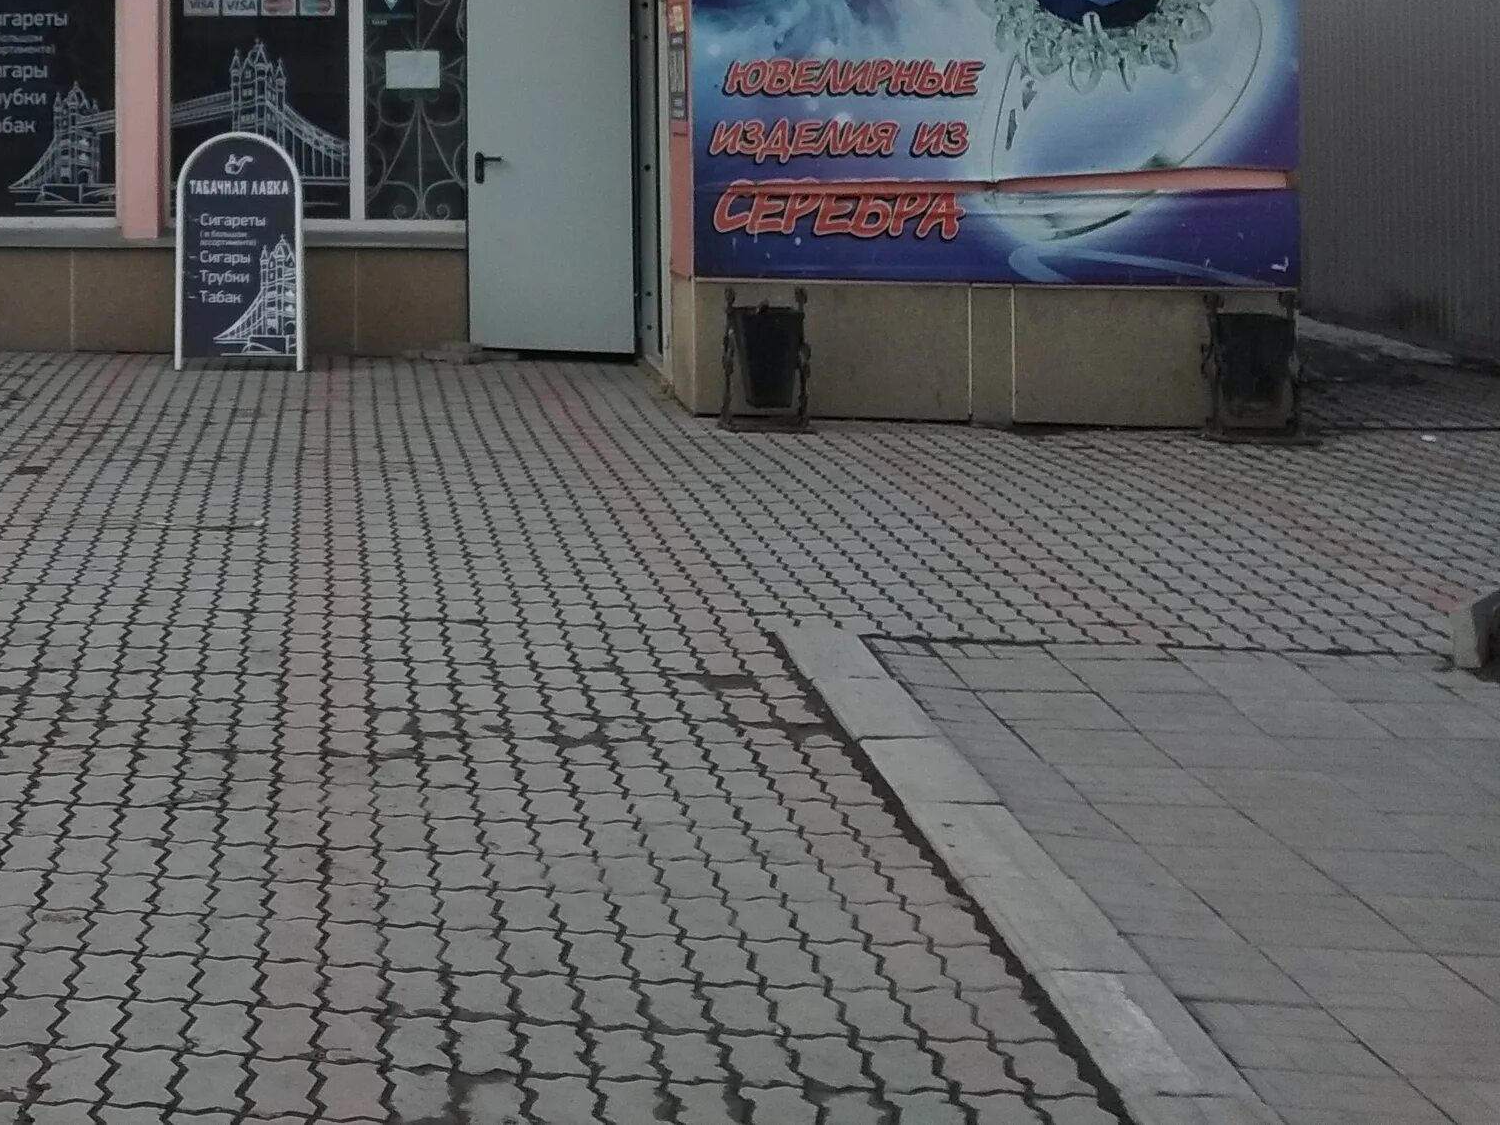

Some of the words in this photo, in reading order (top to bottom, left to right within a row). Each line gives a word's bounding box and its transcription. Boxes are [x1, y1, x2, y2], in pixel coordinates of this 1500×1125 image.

[227, 0, 256, 11] VISA
[724, 59, 984, 96] ЮВЕЛИРНЫЕ
[710, 119, 898, 163] ИЗДЕЛИЯ
[912, 120, 969, 157] ИЗ
[189, 180, 247, 195] ТАБАЧНАЯ
[251, 180, 289, 195] ЛАВКА
[200, 213, 266, 229] Сигареты
[713, 186, 966, 241] СЕРЕБРА
[200, 250, 250, 266] Сигары
[200, 270, 250, 285] Трубки
[200, 290, 241, 303] Табак
